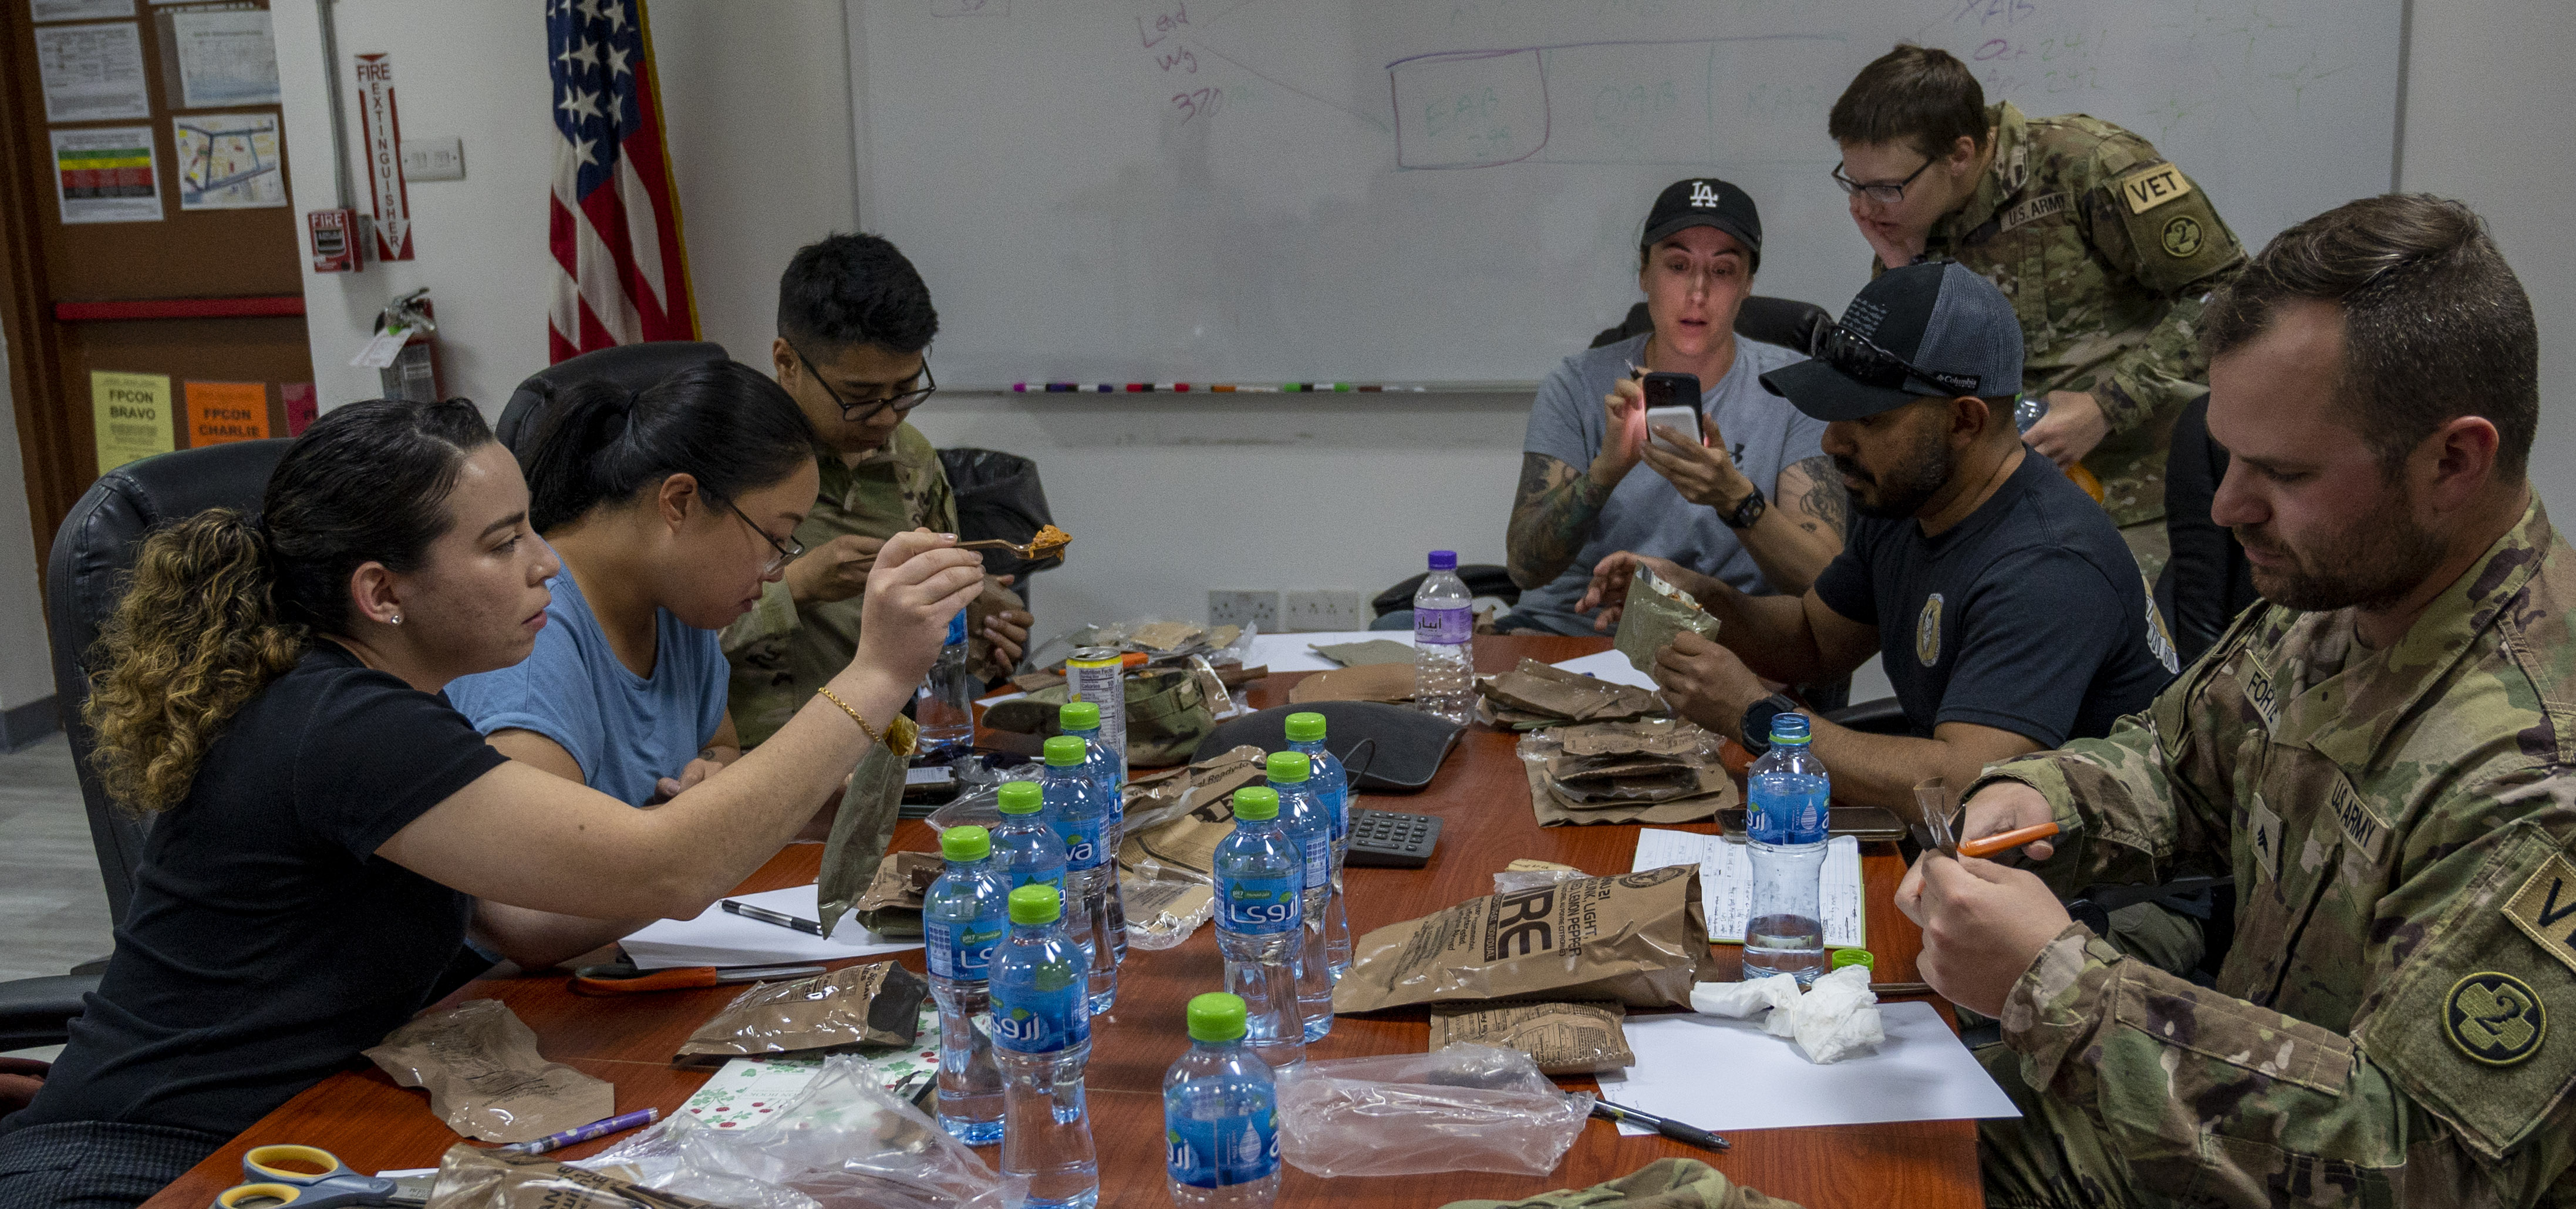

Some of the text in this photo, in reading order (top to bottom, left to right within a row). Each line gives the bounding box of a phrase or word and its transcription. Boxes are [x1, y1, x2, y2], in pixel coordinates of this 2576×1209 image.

[357, 63, 391, 82] FIRE
[371, 82, 400, 248] EXTINGUISHER
[1690, 181, 1719, 208] LA
[2129, 170, 2177, 204] VET
[311, 213, 343, 227] FIRE
[2008, 194, 2065, 225] U.S. ARMY
[2173, 222, 2189, 244] 2
[1944, 376, 1977, 386] Columbia
[109, 389, 154, 404] FPCON
[109, 405, 156, 420] BRAVO
[203, 408, 252, 421] FPCON
[198, 423, 261, 437] CHARLIE
[2331, 779, 2376, 848] U.S. ARMY
[1230, 891, 1299, 924] أروى
[1568, 891, 1582, 916] LEMON
[1599, 889, 1611, 901] 21
[1583, 902, 1598, 939] LIGHT,
[1486, 924, 1496, 959] INDIVIDUAL
[1567, 917, 1583, 958] PEPPER
[862, 972, 878, 1001] SUGAR
[2474, 995, 2521, 1036] 2
